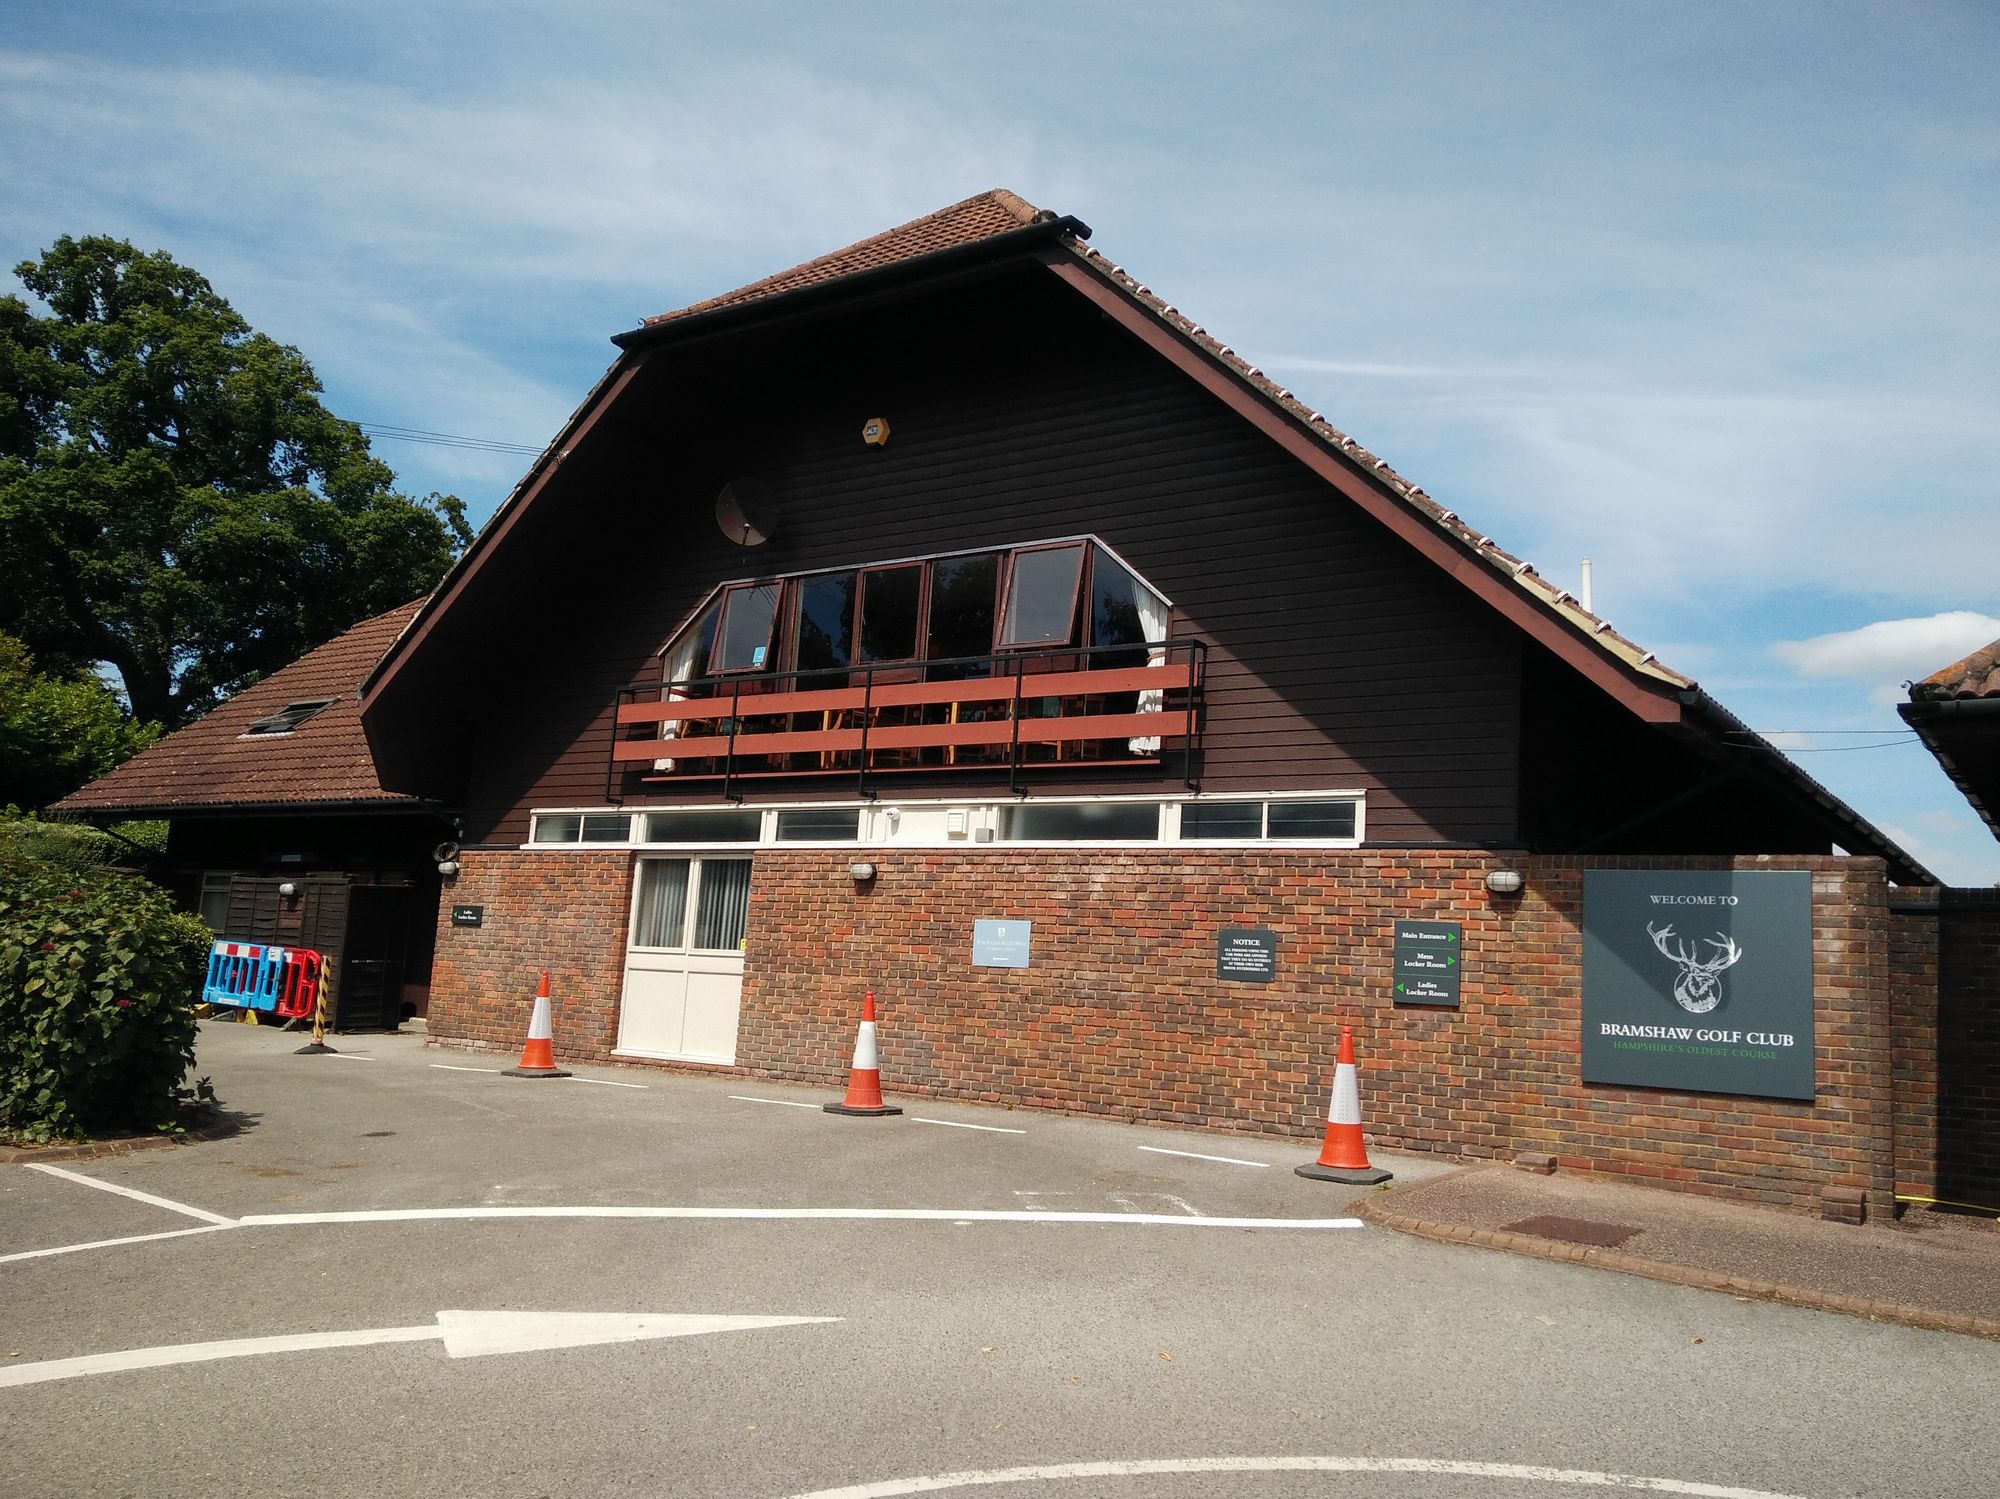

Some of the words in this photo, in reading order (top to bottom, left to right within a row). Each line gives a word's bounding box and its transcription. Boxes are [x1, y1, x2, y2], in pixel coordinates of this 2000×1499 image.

[1650, 895, 1716, 905] WELCOME
[1719, 896, 1738, 905] TO
[1600, 1023, 1694, 1041] BRAMSHAW
[1696, 1029, 1741, 1043] GOLF
[1746, 1032, 1794, 1047] CLUB
[1614, 1041, 1683, 1053] HAMPSHIRE'S
[1687, 1046, 1728, 1056] OLDEST
[1732, 1048, 1777, 1060] COURSE
